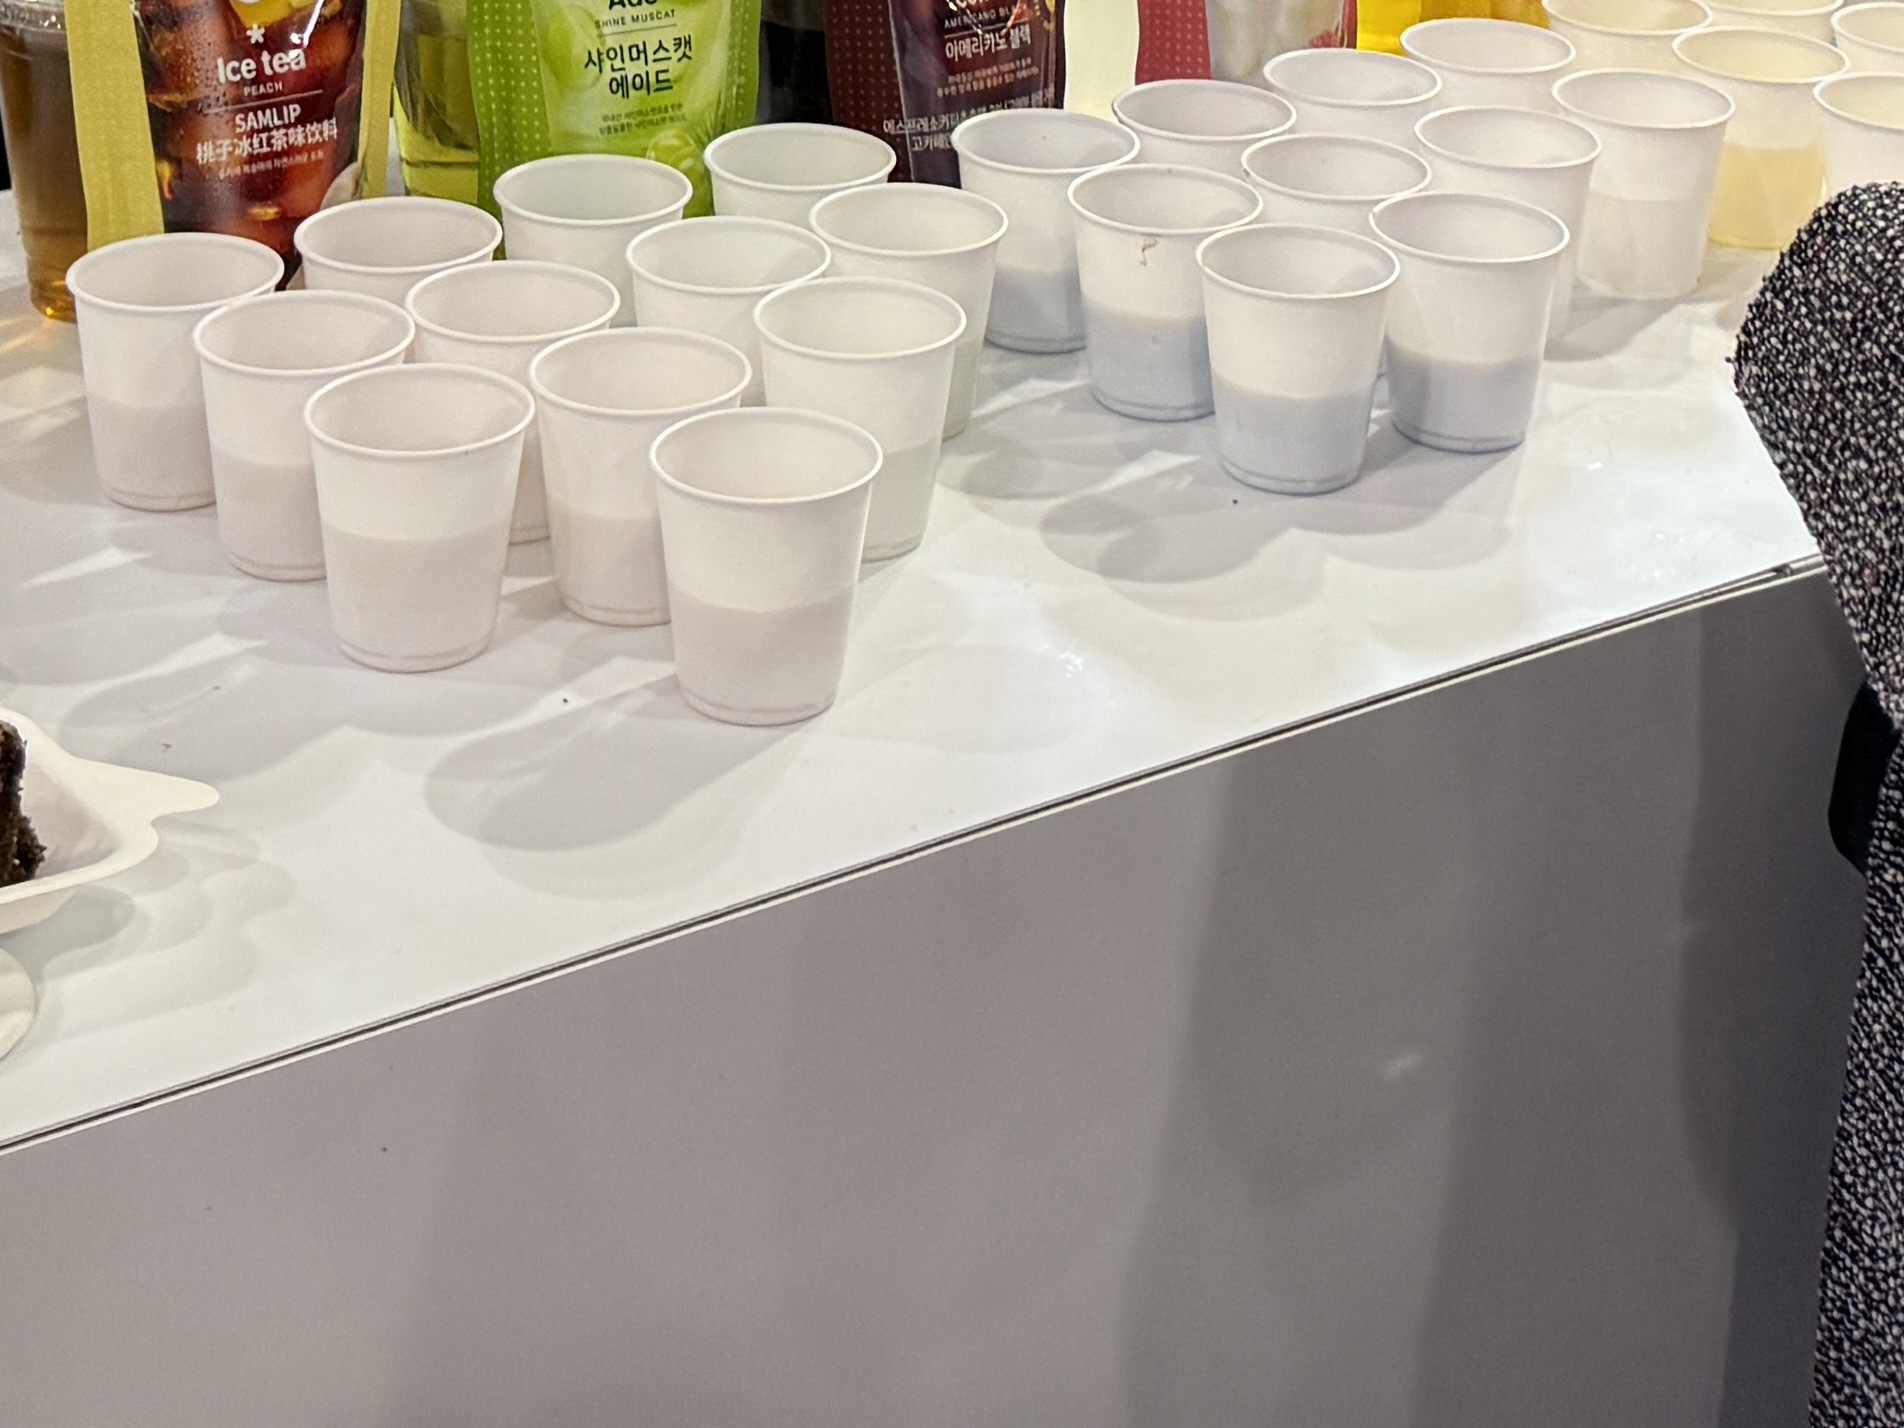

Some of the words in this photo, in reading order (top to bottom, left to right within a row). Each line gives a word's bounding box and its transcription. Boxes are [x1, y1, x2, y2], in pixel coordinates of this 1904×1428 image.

[595, 15, 627, 30] SHINE
[631, 9, 676, 24] MUSCAT
[216, 56, 257, 84] Ice
[260, 48, 307, 76] tea
[584, 33, 693, 74] 샤인머스캣
[243, 81, 283, 97] PEACH
[608, 68, 674, 99] 에이드
[234, 103, 302, 134] SAMLIP
[195, 116, 338, 165] 桃子冰红茶味饮料
